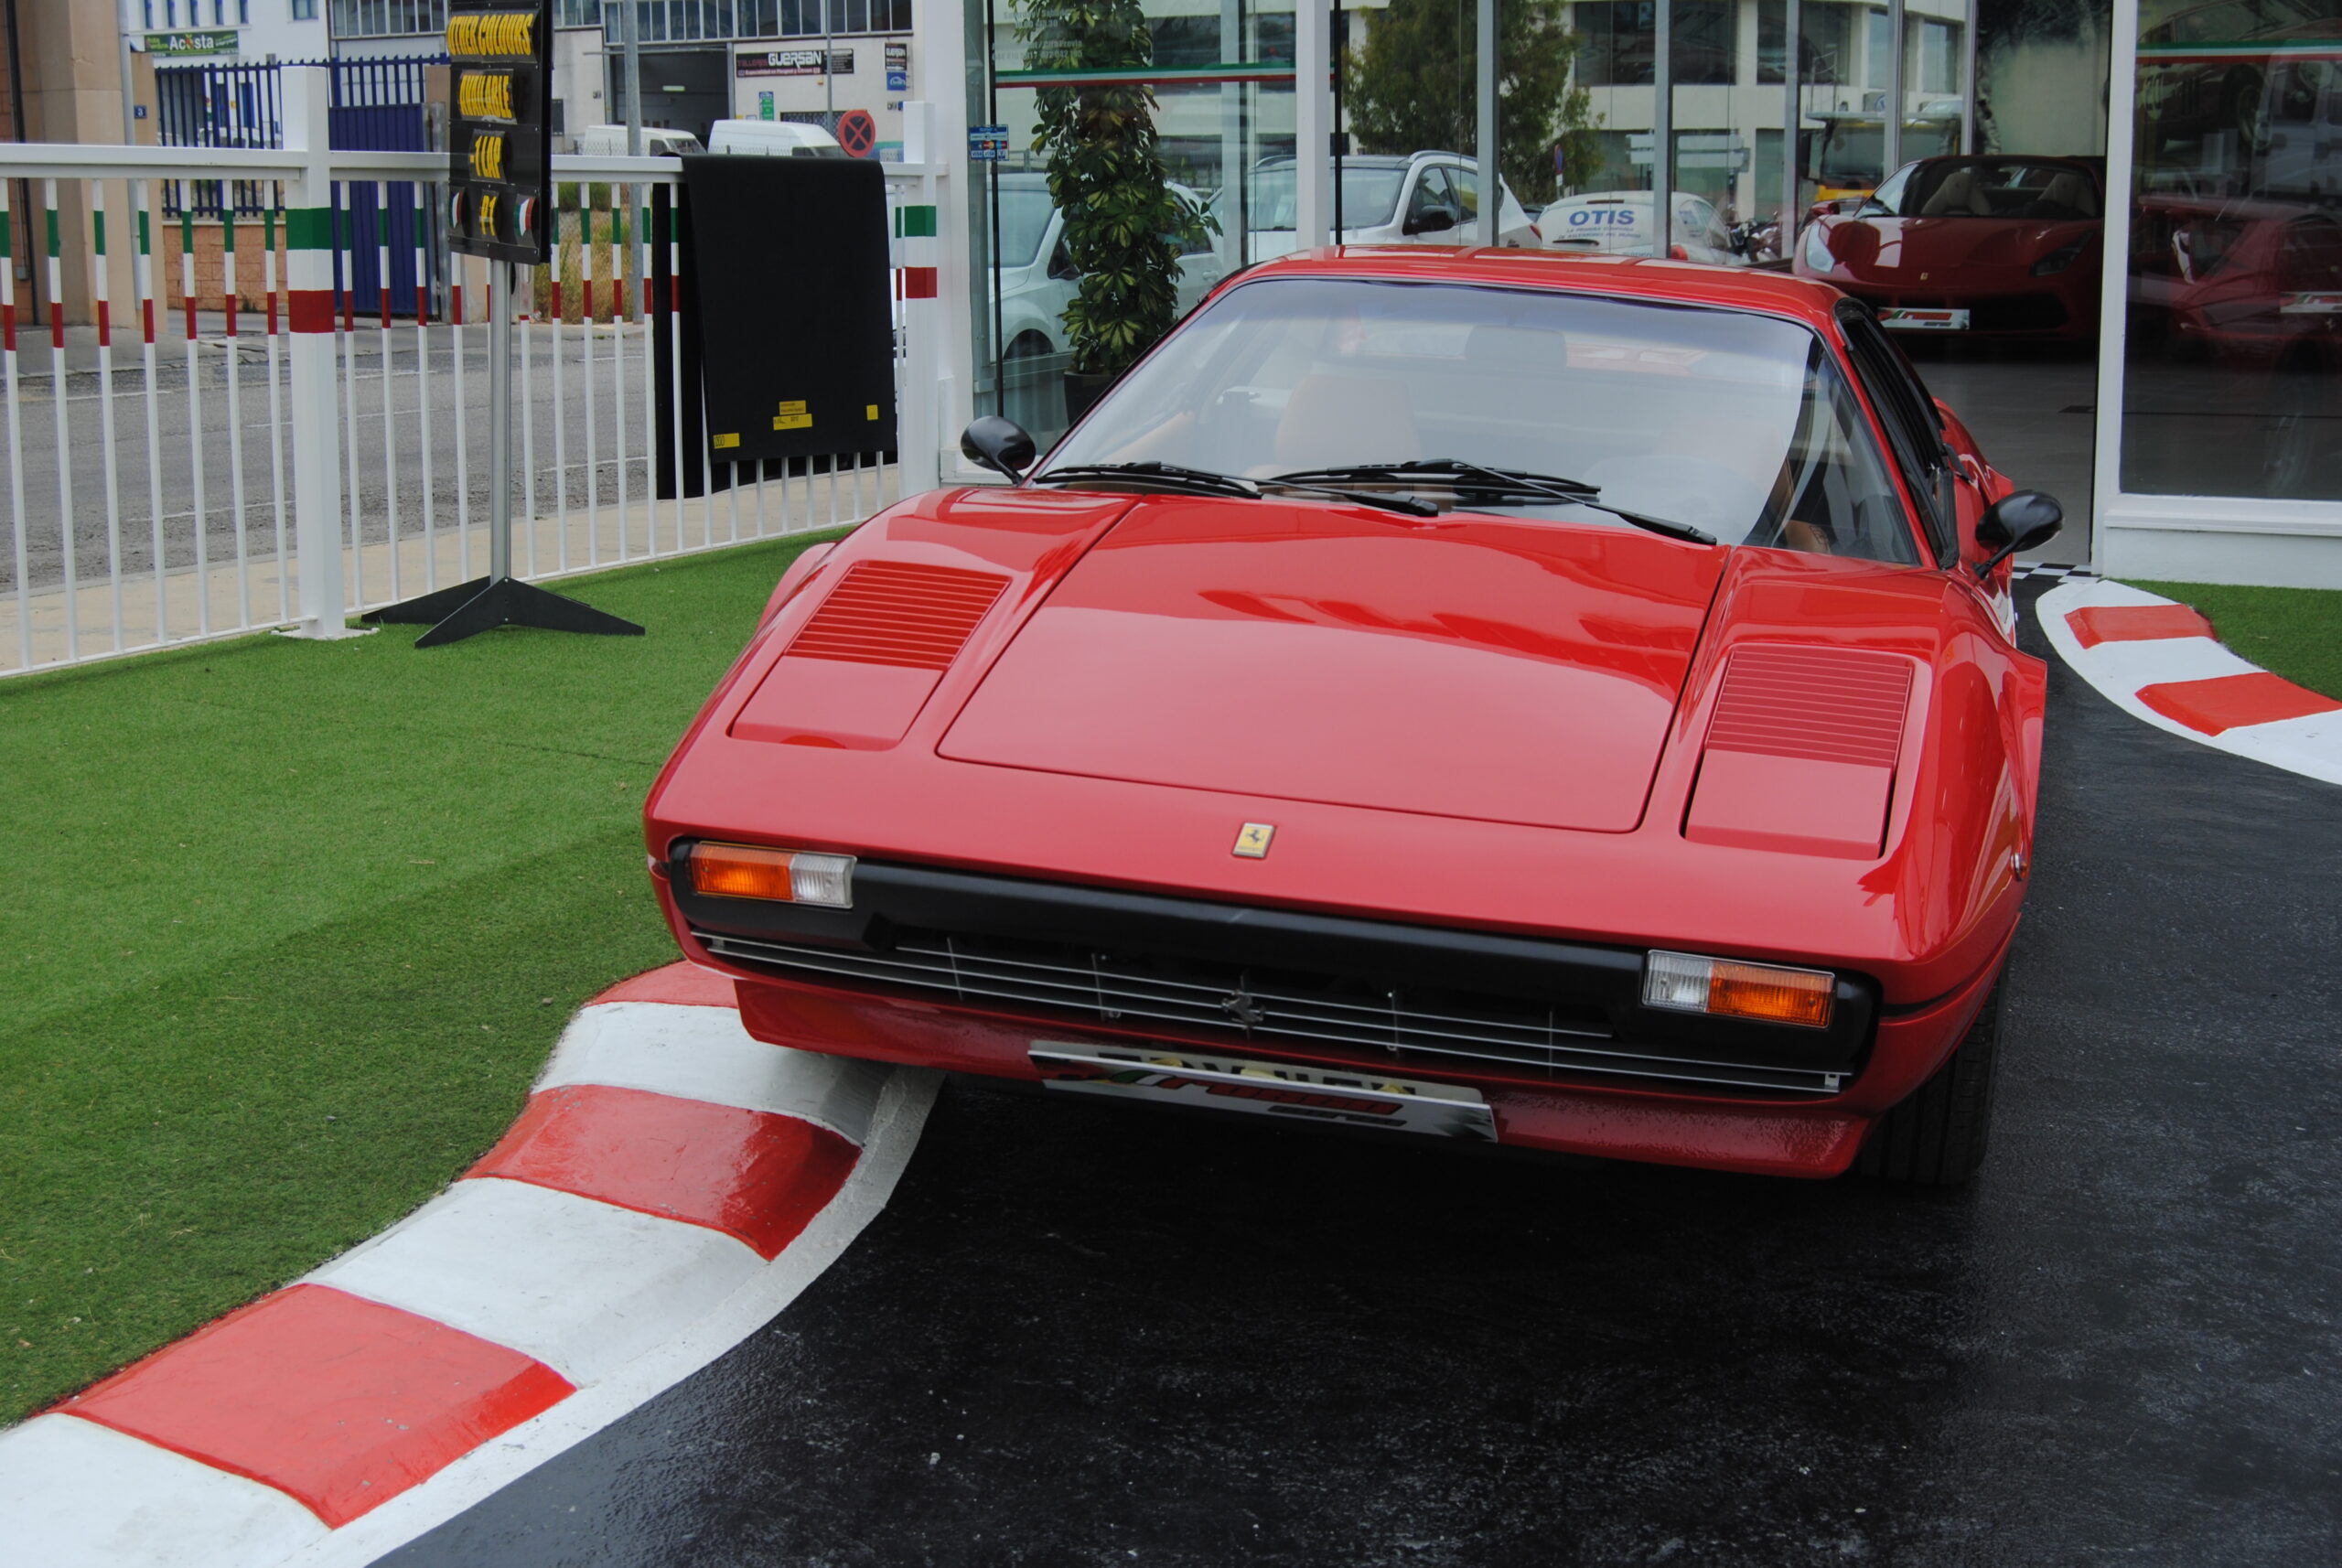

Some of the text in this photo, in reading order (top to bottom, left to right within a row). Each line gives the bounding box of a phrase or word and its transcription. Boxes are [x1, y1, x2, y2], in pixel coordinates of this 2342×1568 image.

[446, 13, 534, 55] OTHER COLOURS
[459, 74, 512, 119] AVAILABLE
[481, 135, 502, 178] LAP
[1569, 209, 1635, 226] OTIS
